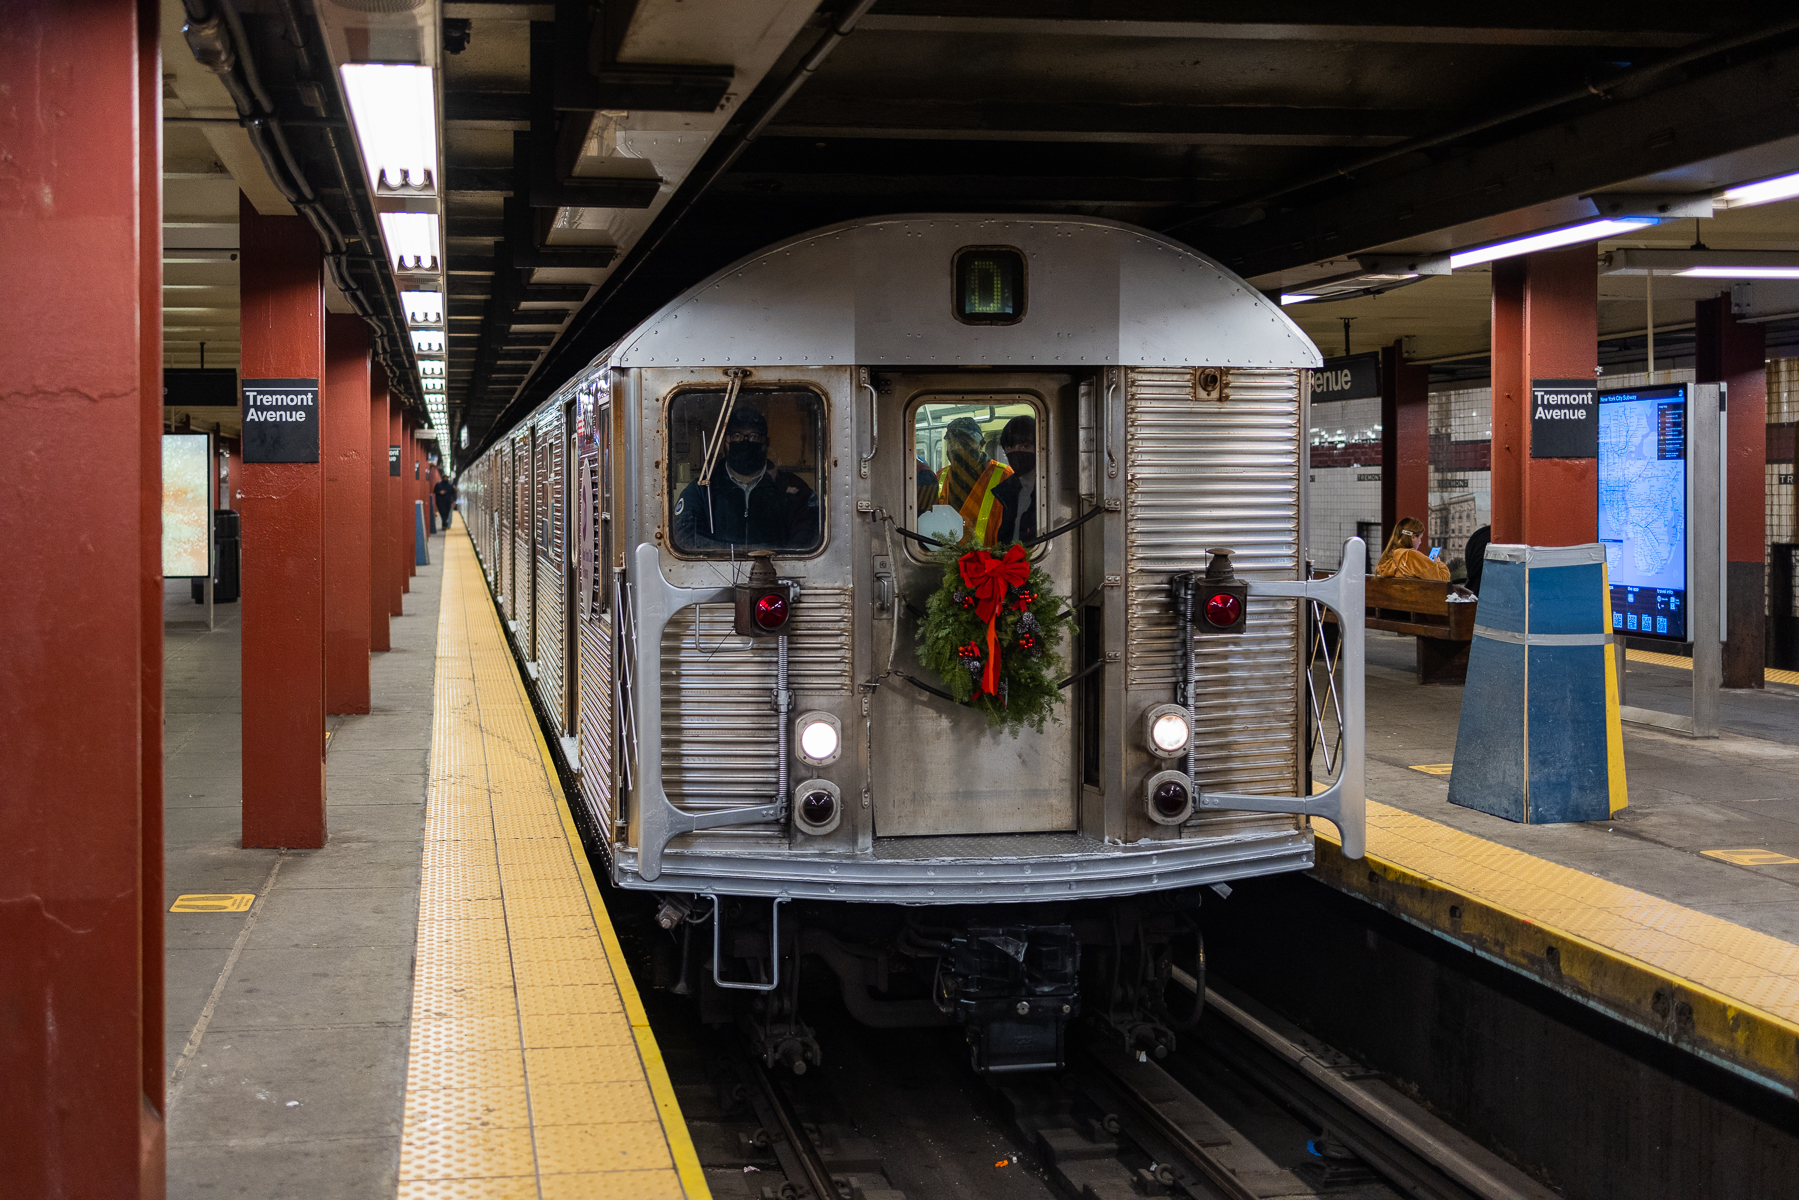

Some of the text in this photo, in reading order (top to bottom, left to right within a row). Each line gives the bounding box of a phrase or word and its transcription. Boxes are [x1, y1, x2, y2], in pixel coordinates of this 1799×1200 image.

[1314, 369, 1352, 393] enue
[245, 391, 314, 406] Tremont
[1534, 391, 1593, 405] Tremont
[246, 407, 306, 422] Avenue
[1534, 406, 1587, 420] Avenue
